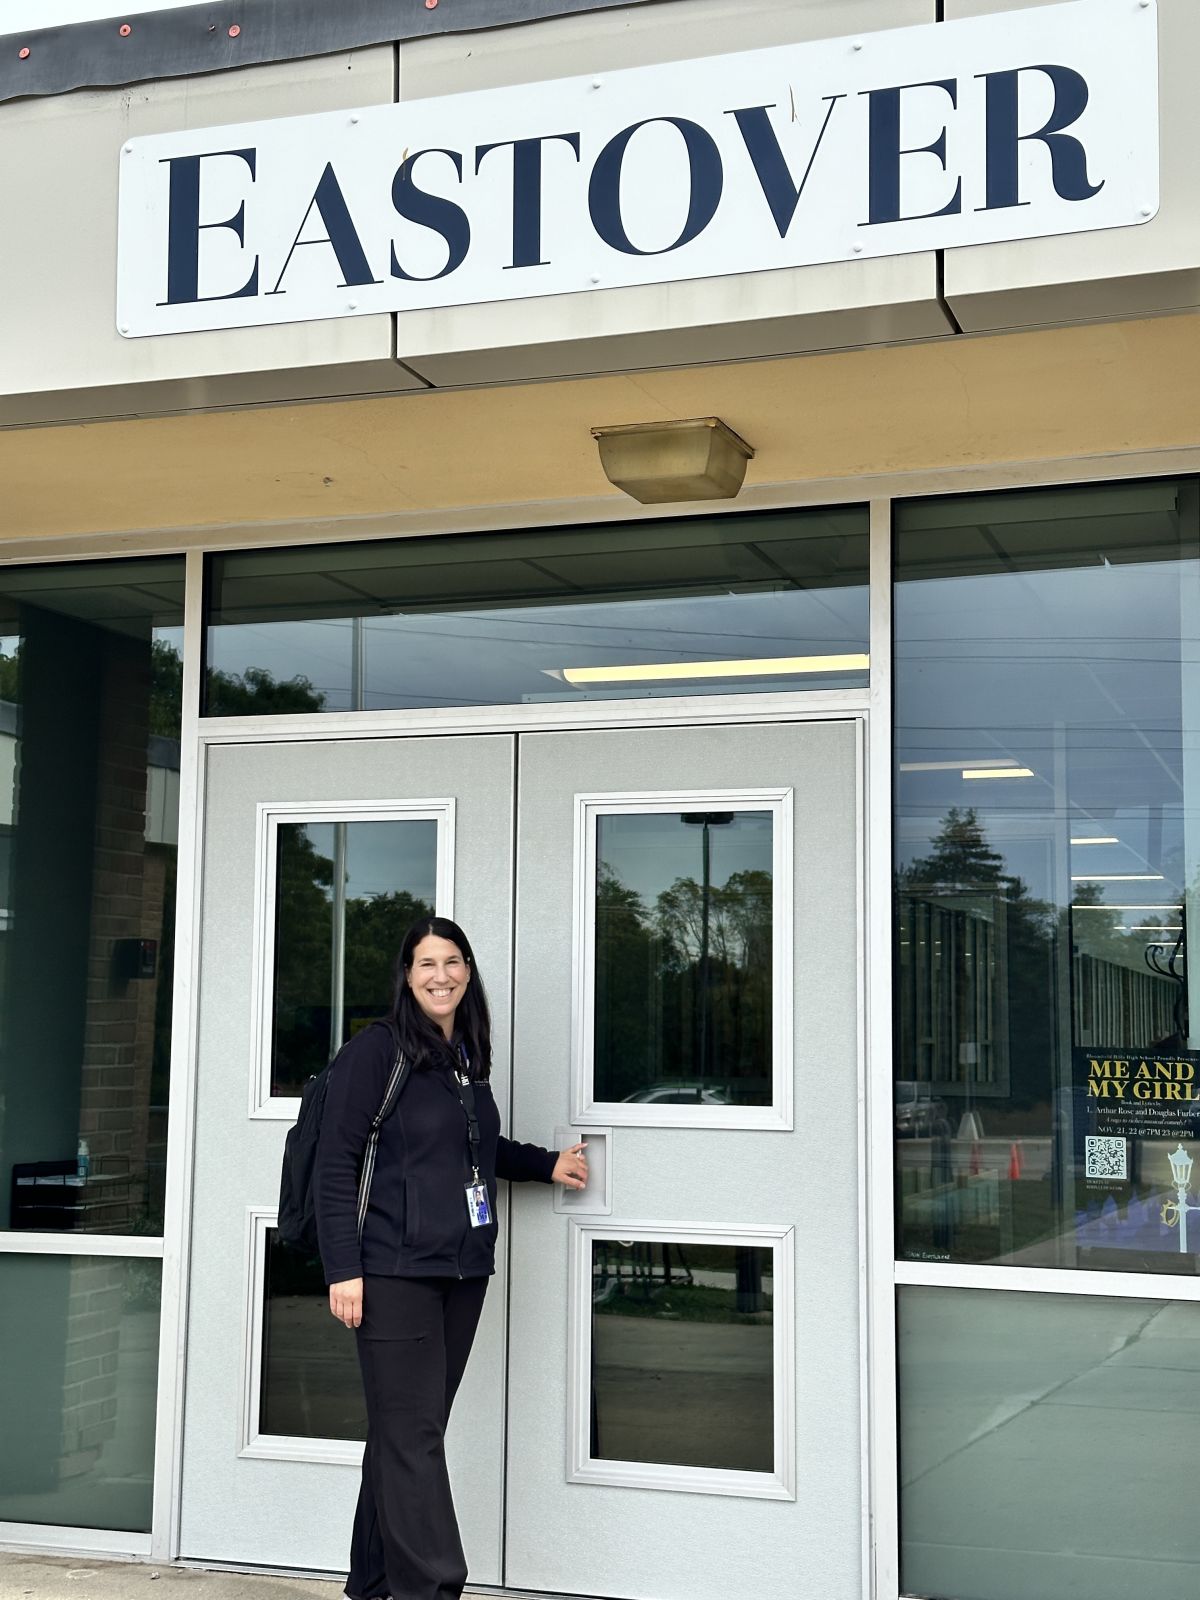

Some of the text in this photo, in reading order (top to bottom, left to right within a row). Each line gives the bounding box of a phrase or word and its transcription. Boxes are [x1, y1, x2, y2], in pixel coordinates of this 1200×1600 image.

[156, 64, 1104, 306] EASTOVER
[1088, 1060, 1195, 1080] ME AND
[1086, 1079, 1200, 1101] MY GIRL
[1096, 1106, 1118, 1114] Arthur
[1118, 1107, 1134, 1115] Rose
[1148, 1108, 1176, 1118] Douglas
[1128, 1127, 1138, 1135] 22
